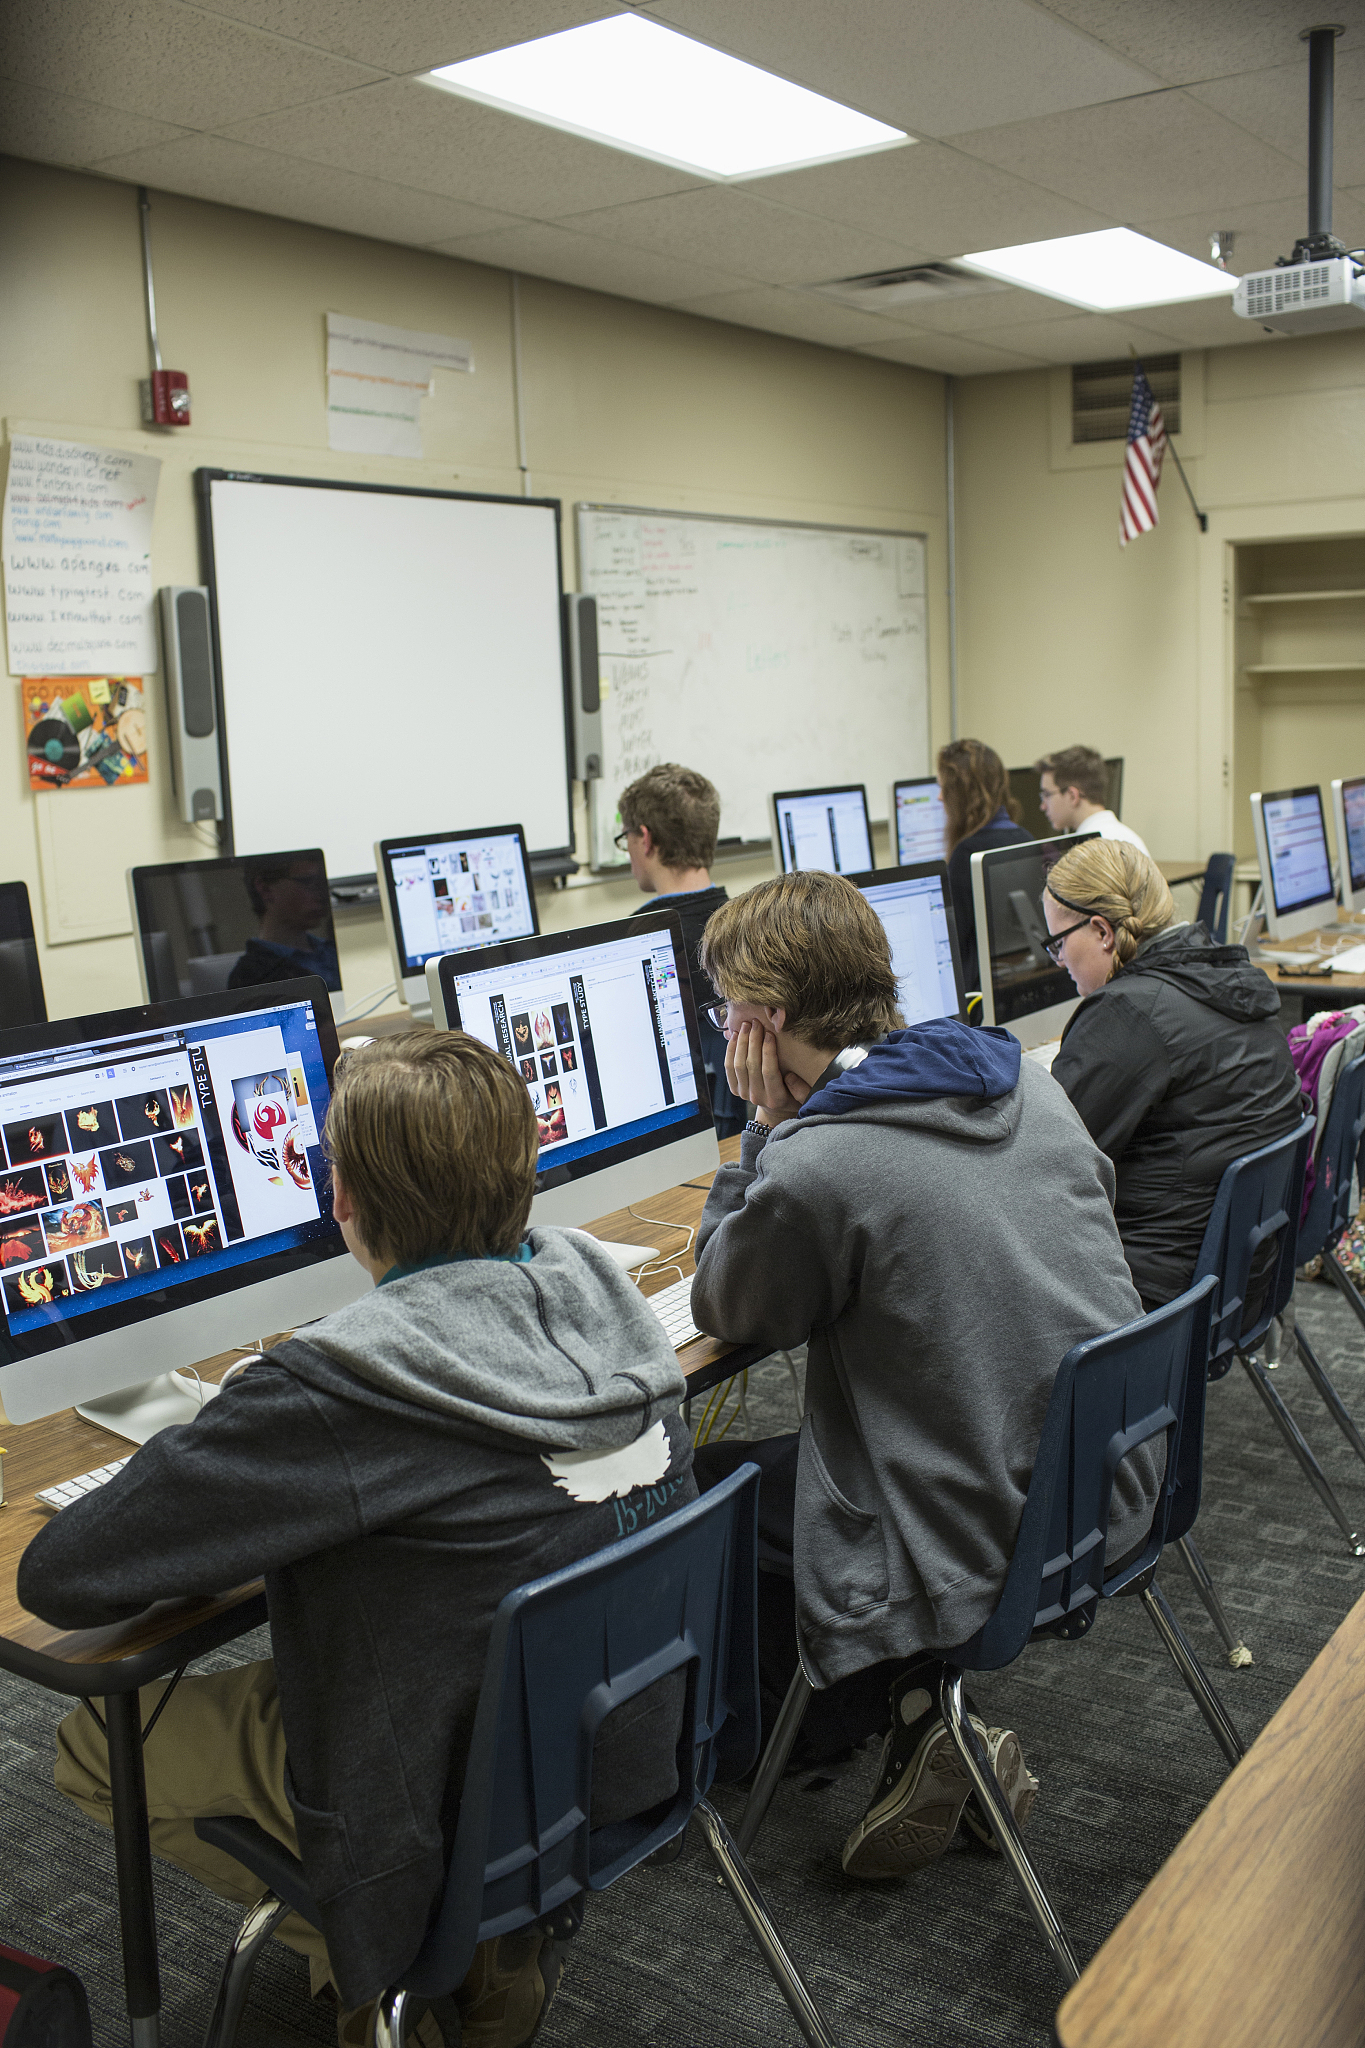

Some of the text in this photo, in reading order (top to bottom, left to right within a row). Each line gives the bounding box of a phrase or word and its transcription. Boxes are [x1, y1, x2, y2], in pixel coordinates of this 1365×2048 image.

[497, 1001, 510, 1044] RESEARCH
[576, 982, 589, 1030] TYPE STUDY
[197, 1074, 212, 1108] TYPE
